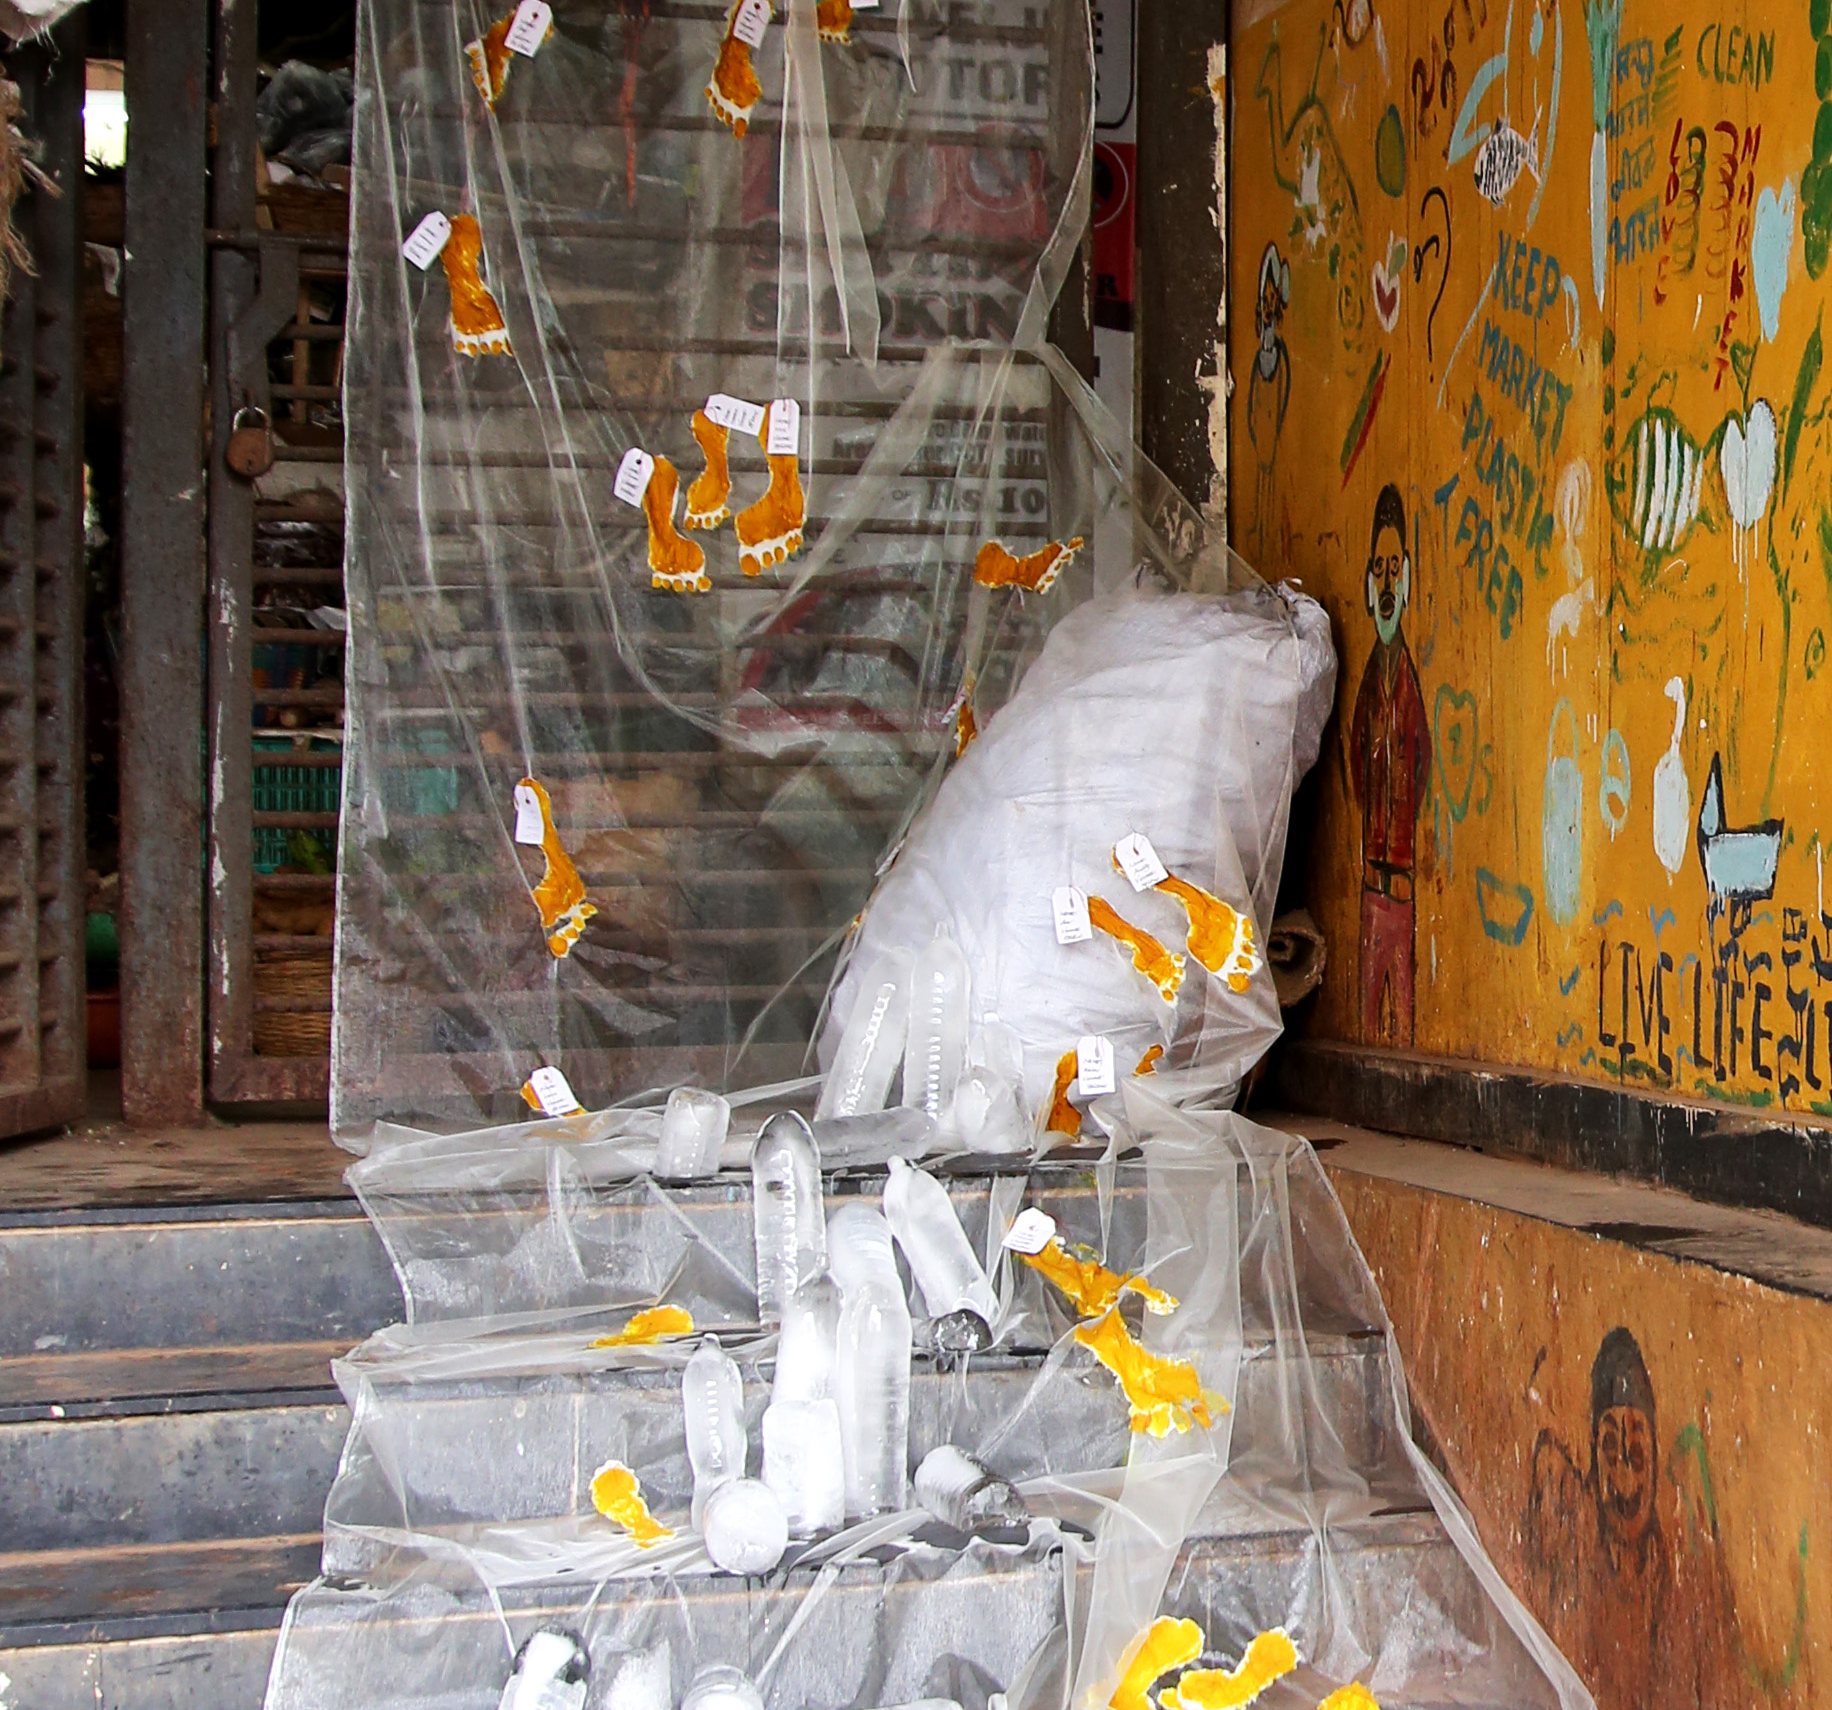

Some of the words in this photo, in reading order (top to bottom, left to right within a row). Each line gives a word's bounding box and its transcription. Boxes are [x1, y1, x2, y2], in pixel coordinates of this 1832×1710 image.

[1696, 23, 1776, 93] CLEAN
[1493, 230, 1560, 320] KEEP
[1477, 318, 1573, 458] MARKET
[1599, 940, 1673, 1077] LIVE
[1694, 958, 1772, 1082] LIFE
